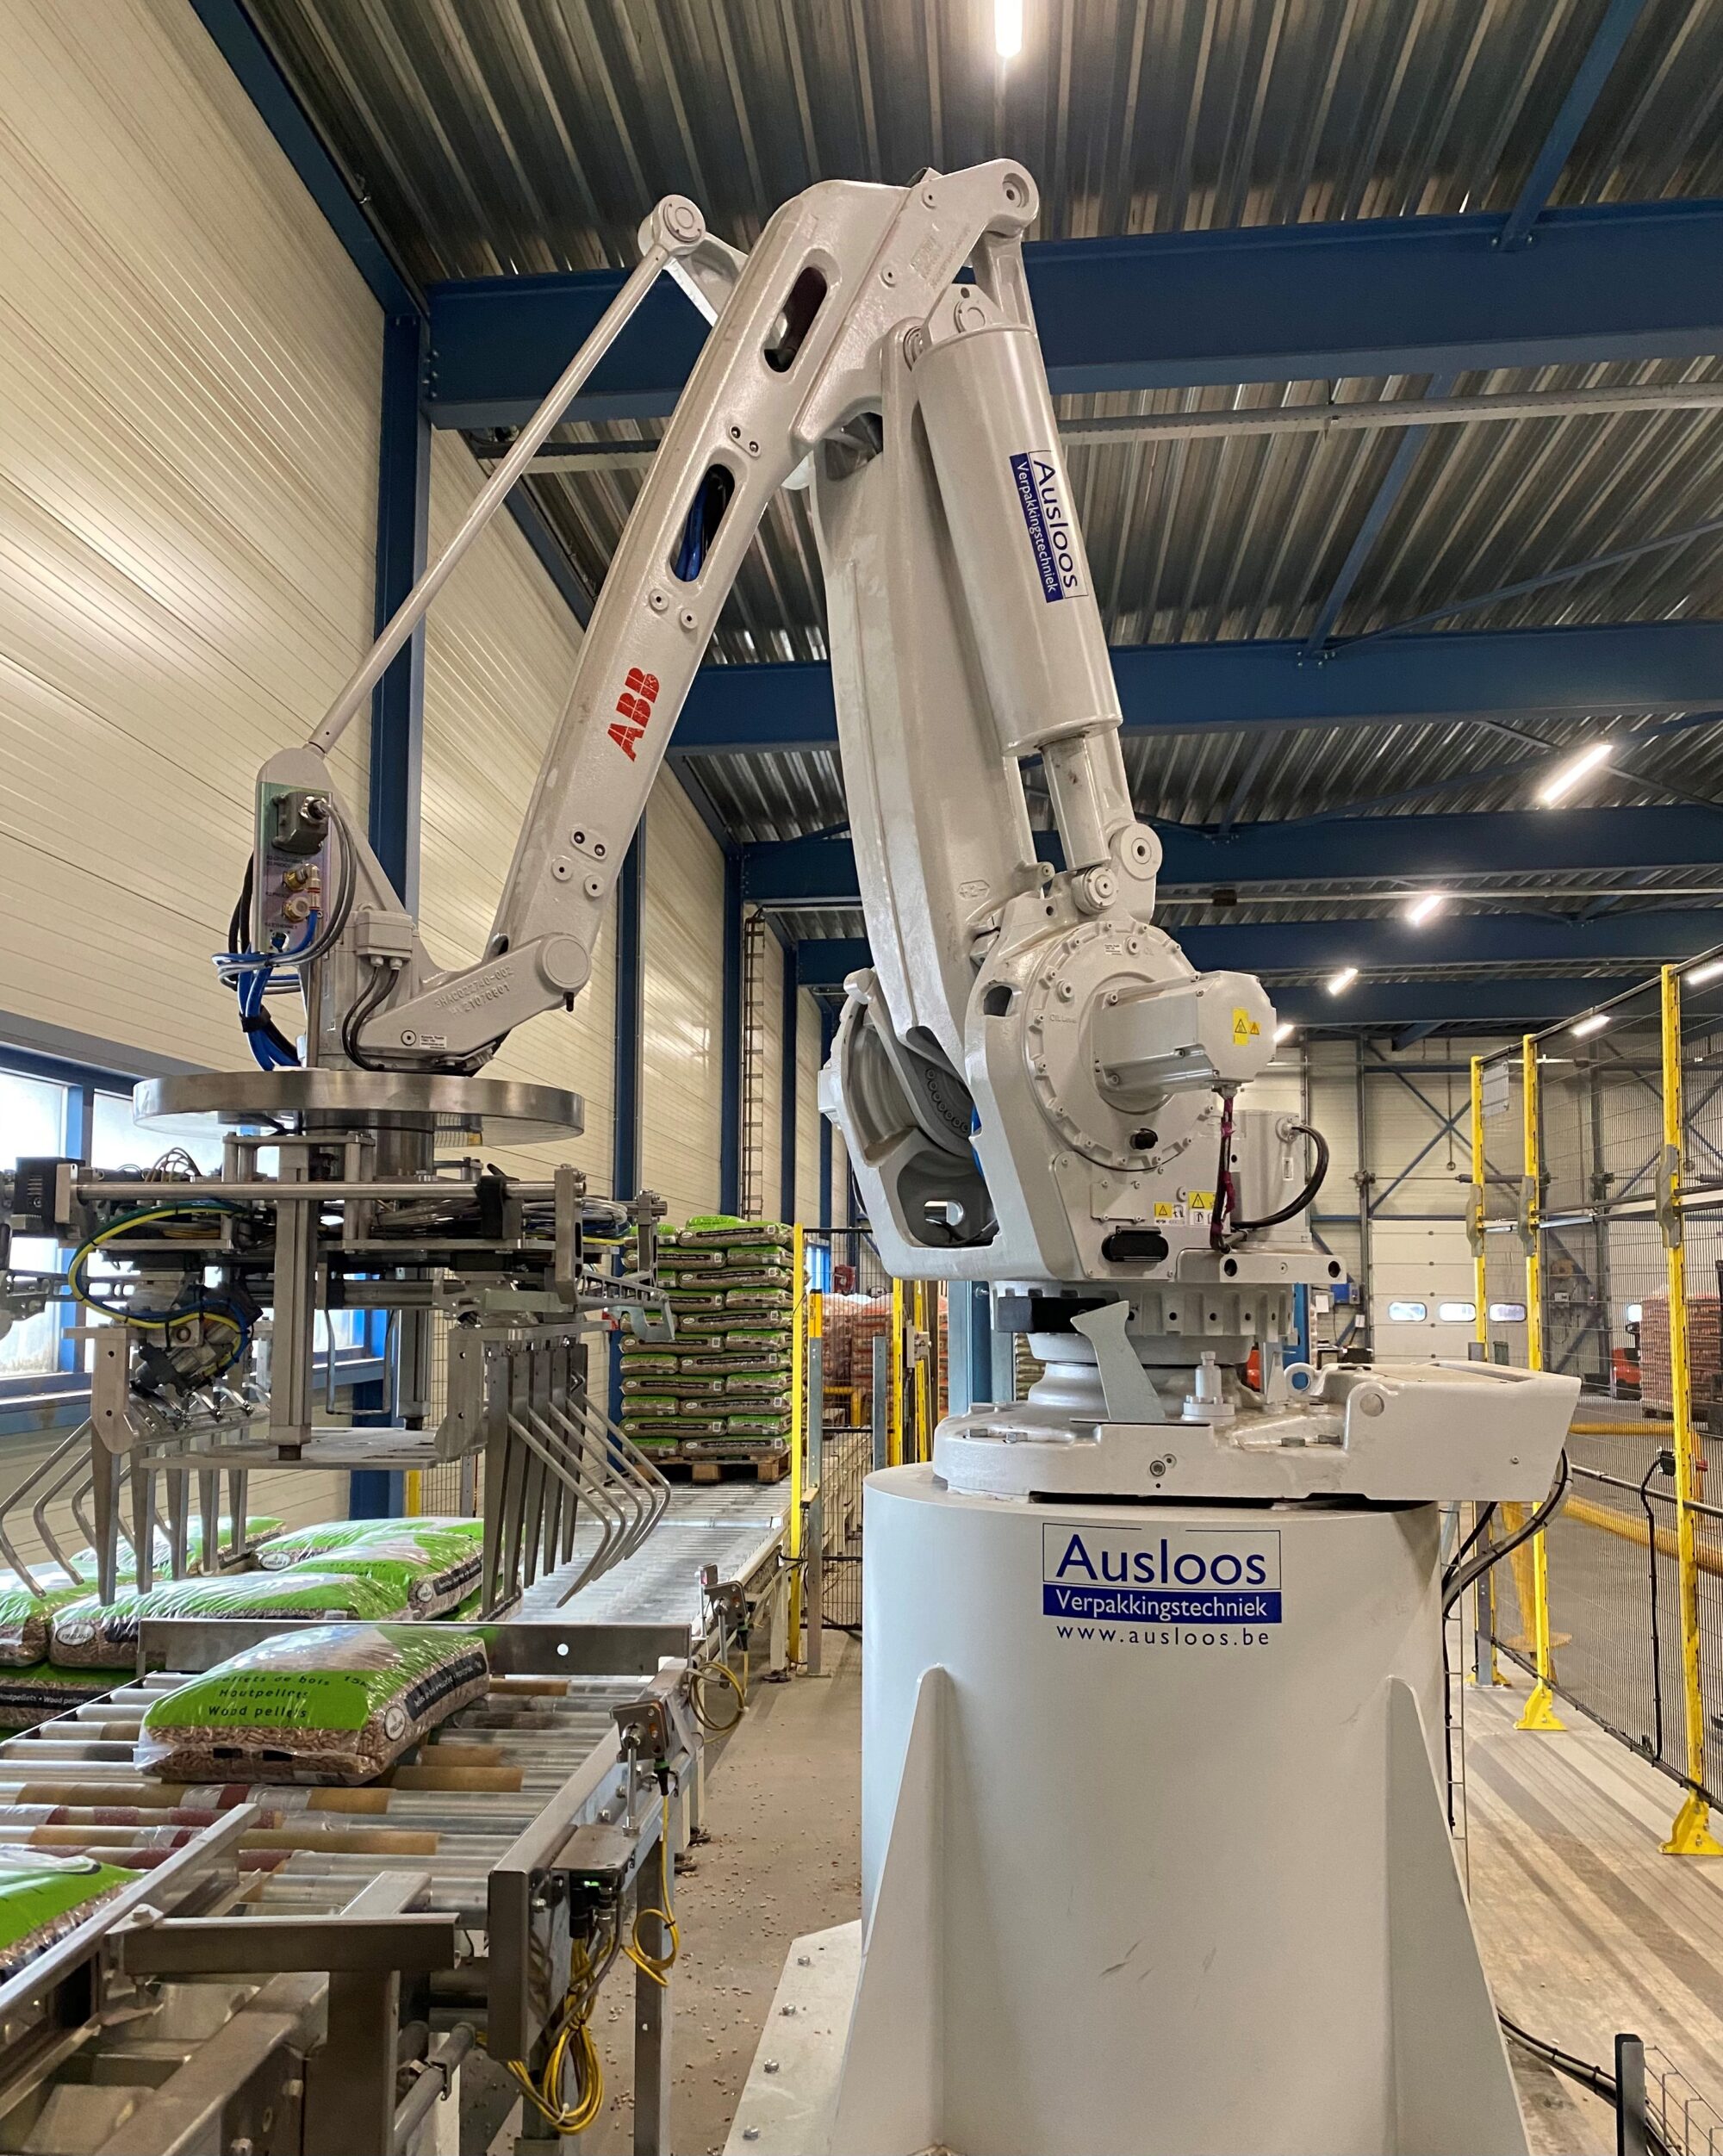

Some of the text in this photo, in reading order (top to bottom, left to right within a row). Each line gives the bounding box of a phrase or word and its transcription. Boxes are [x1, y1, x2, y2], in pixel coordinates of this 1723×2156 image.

[1017, 461, 1057, 593] Verpakkingstechniek
[1034, 460, 1078, 588] Ausloos
[607, 667, 660, 763] ABB
[1055, 1533, 1266, 1585] Ausloos
[1055, 1589, 1267, 1621] Verpakkingstechniek
[1056, 1625, 1269, 1646] www.ausloos.be
[219, 1688, 308, 1699] Houtpellets
[299, 1675, 330, 1686] bois
[43, 1695, 63, 1704] Wood
[208, 1706, 248, 1717] Wood
